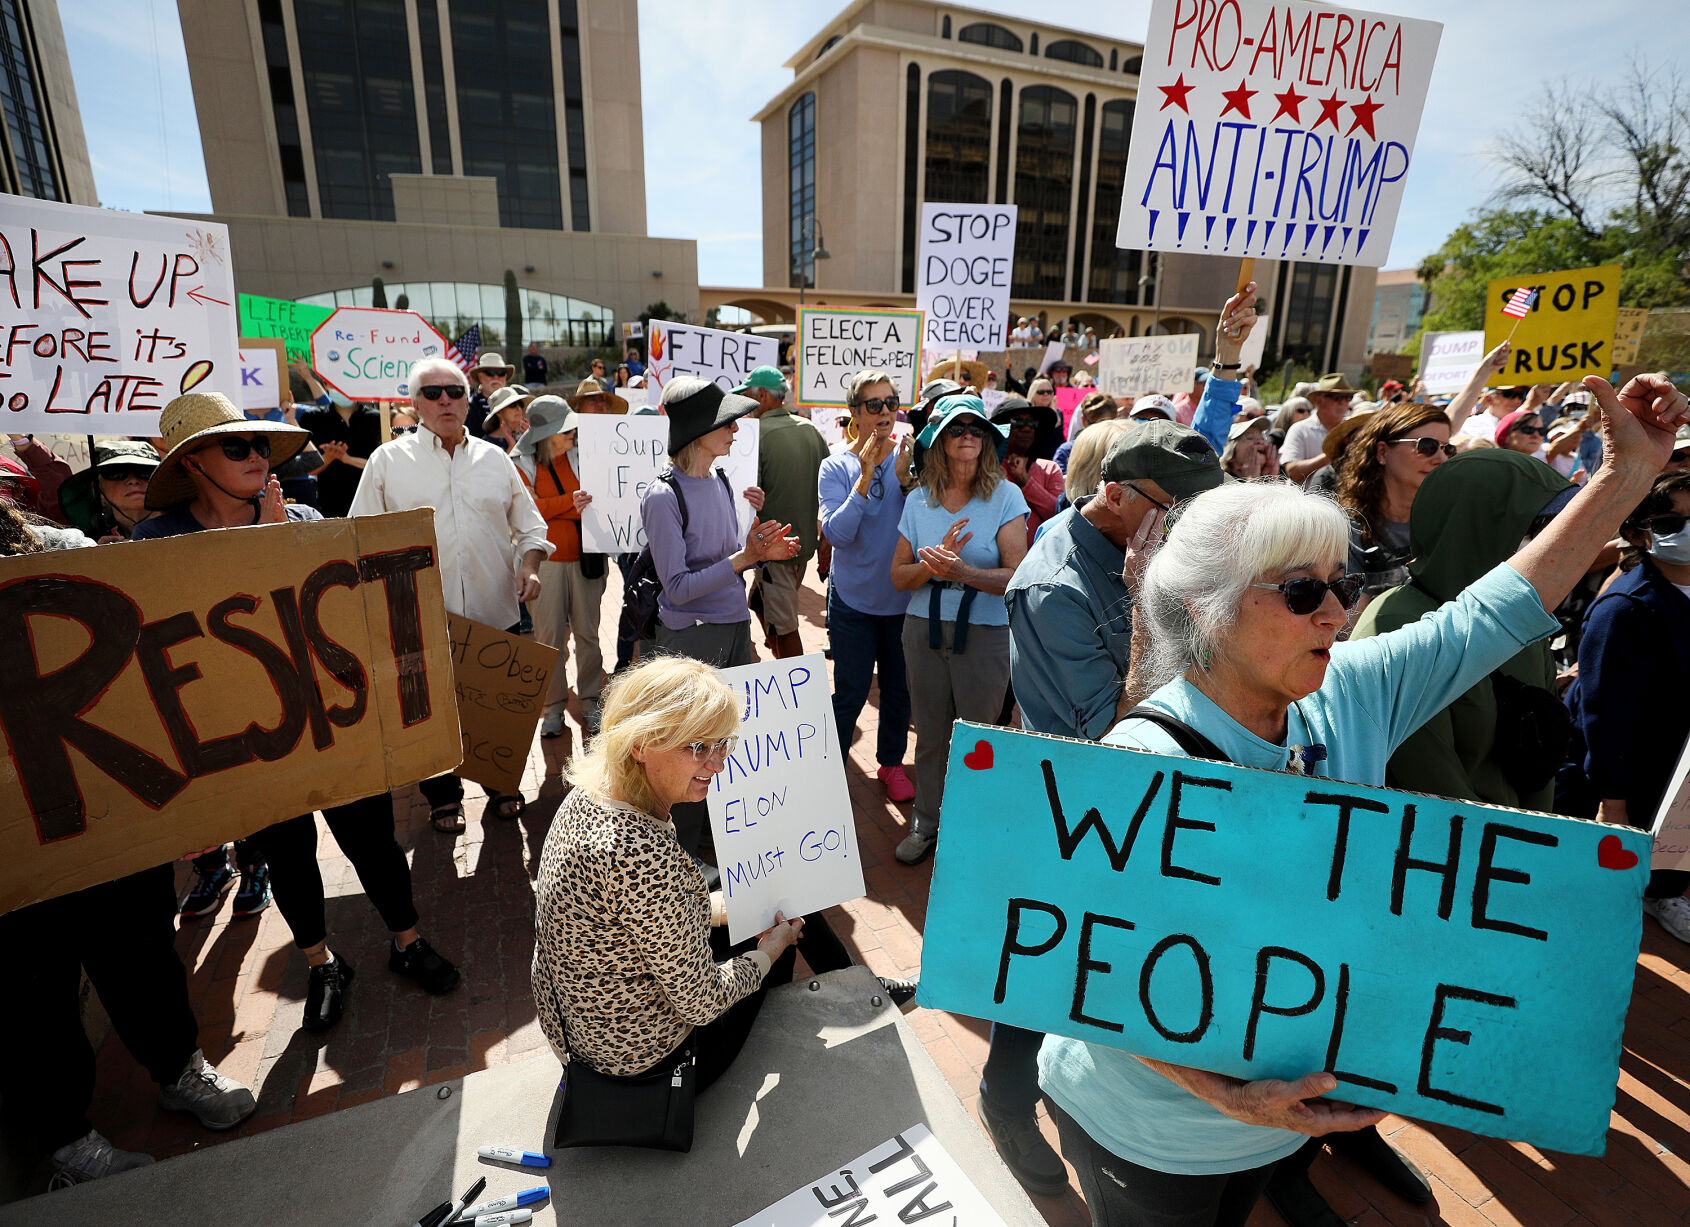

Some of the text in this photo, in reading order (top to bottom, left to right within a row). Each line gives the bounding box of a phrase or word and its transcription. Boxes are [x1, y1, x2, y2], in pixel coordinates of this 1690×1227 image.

[1168, 0, 1402, 95] PRO-AMERICA
[1140, 119, 1409, 226] ANTI-TRUMP
[928, 212, 1011, 244] STOP
[128, 251, 199, 309] UP
[926, 255, 1009, 287] DOGE
[249, 297, 297, 324] LIFE
[932, 295, 996, 321] OVER
[0, 324, 187, 366] FORE it's
[667, 329, 762, 373] FIRE
[812, 318, 902, 344] ELECT A
[927, 319, 1002, 346] REACH
[1431, 340, 1478, 356] DUMP
[1498, 341, 1605, 375] RUSK
[813, 371, 828, 389] A
[477, 639, 548, 698] Obey
[0, 545, 435, 845] RESIST
[725, 785, 787, 834] ELON
[799, 824, 848, 862] GO!
[1041, 759, 1559, 941] WE THE
[993, 897, 1518, 1116] PEOPLE
